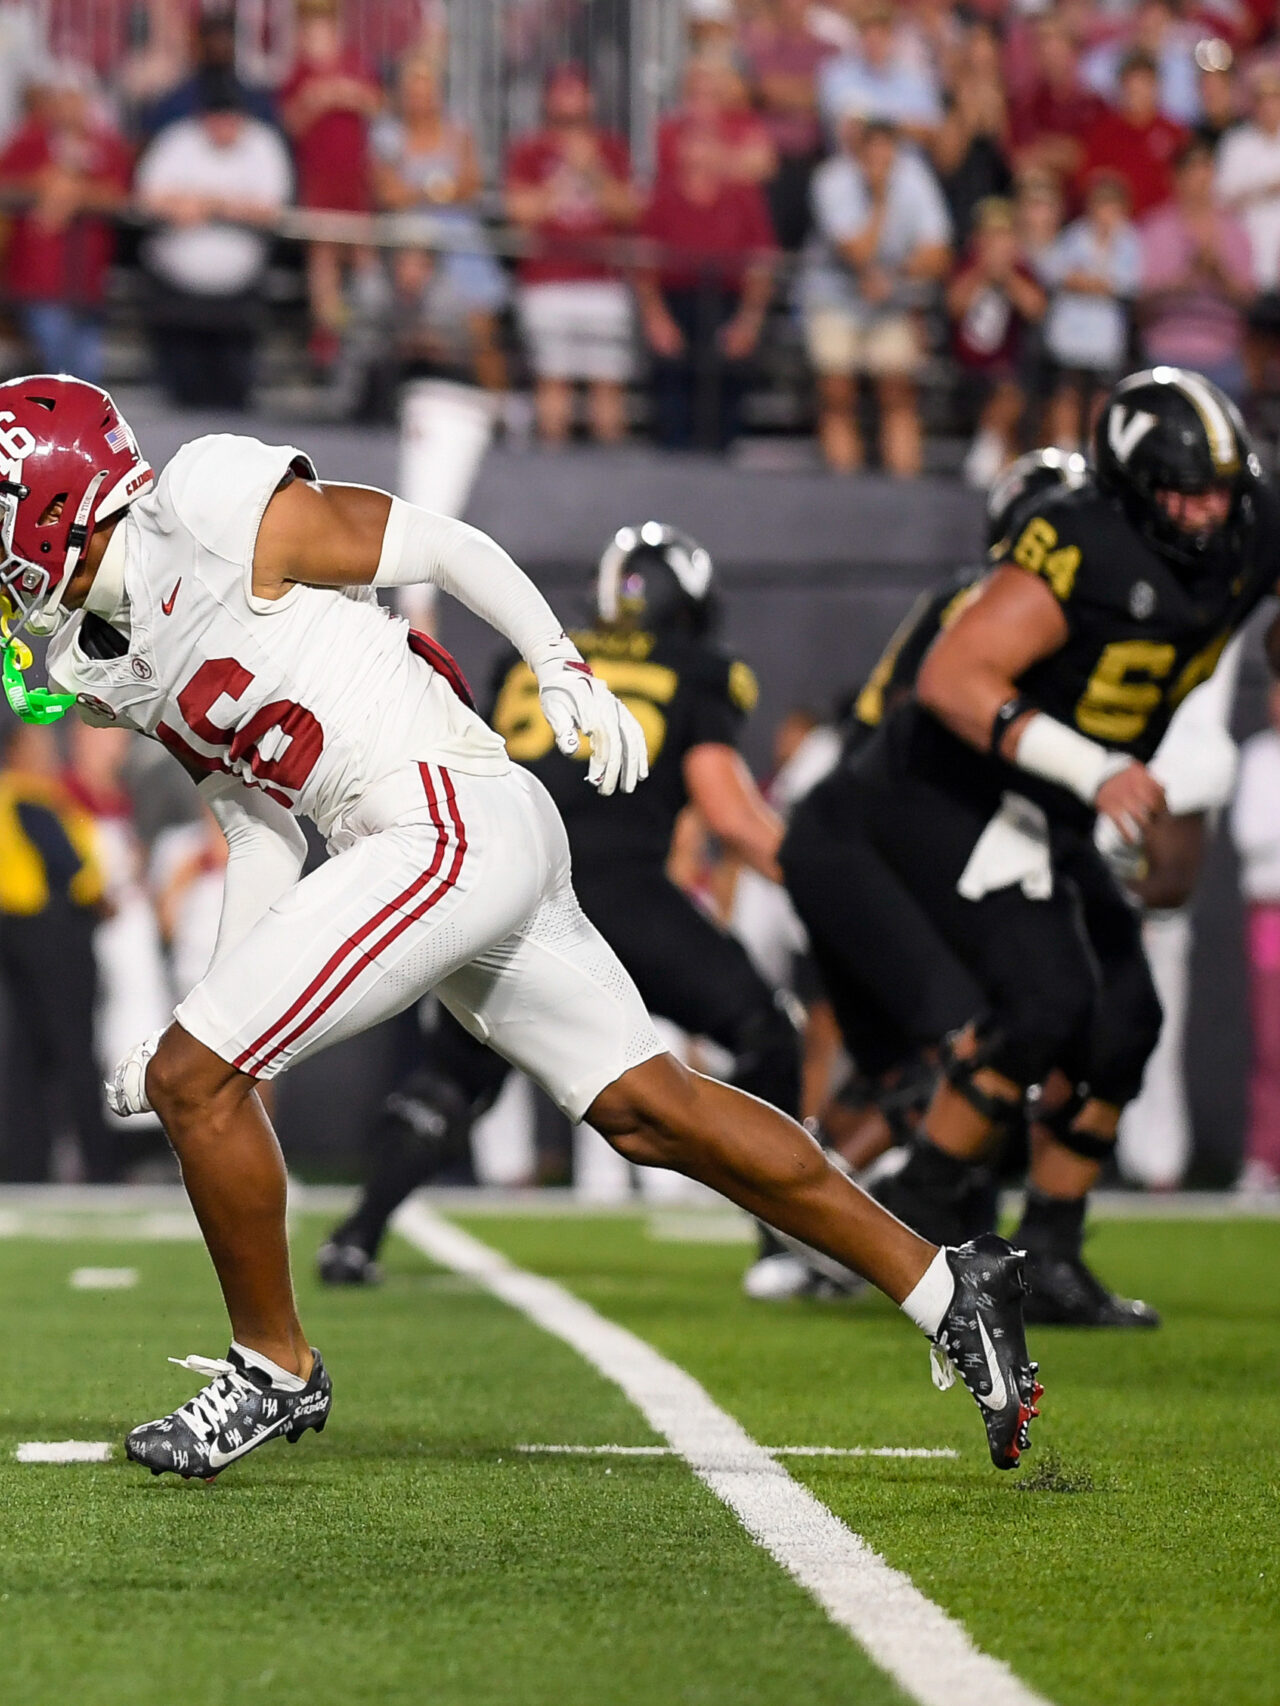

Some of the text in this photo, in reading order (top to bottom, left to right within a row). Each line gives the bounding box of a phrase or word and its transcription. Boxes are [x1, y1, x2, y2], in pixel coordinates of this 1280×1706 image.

[1108, 404, 1157, 463] V
[1014, 517, 1081, 599] 64
[262, 1398, 278, 1419] HA
[225, 1428, 243, 1448] HA
[172, 1450, 188, 1470] HA
